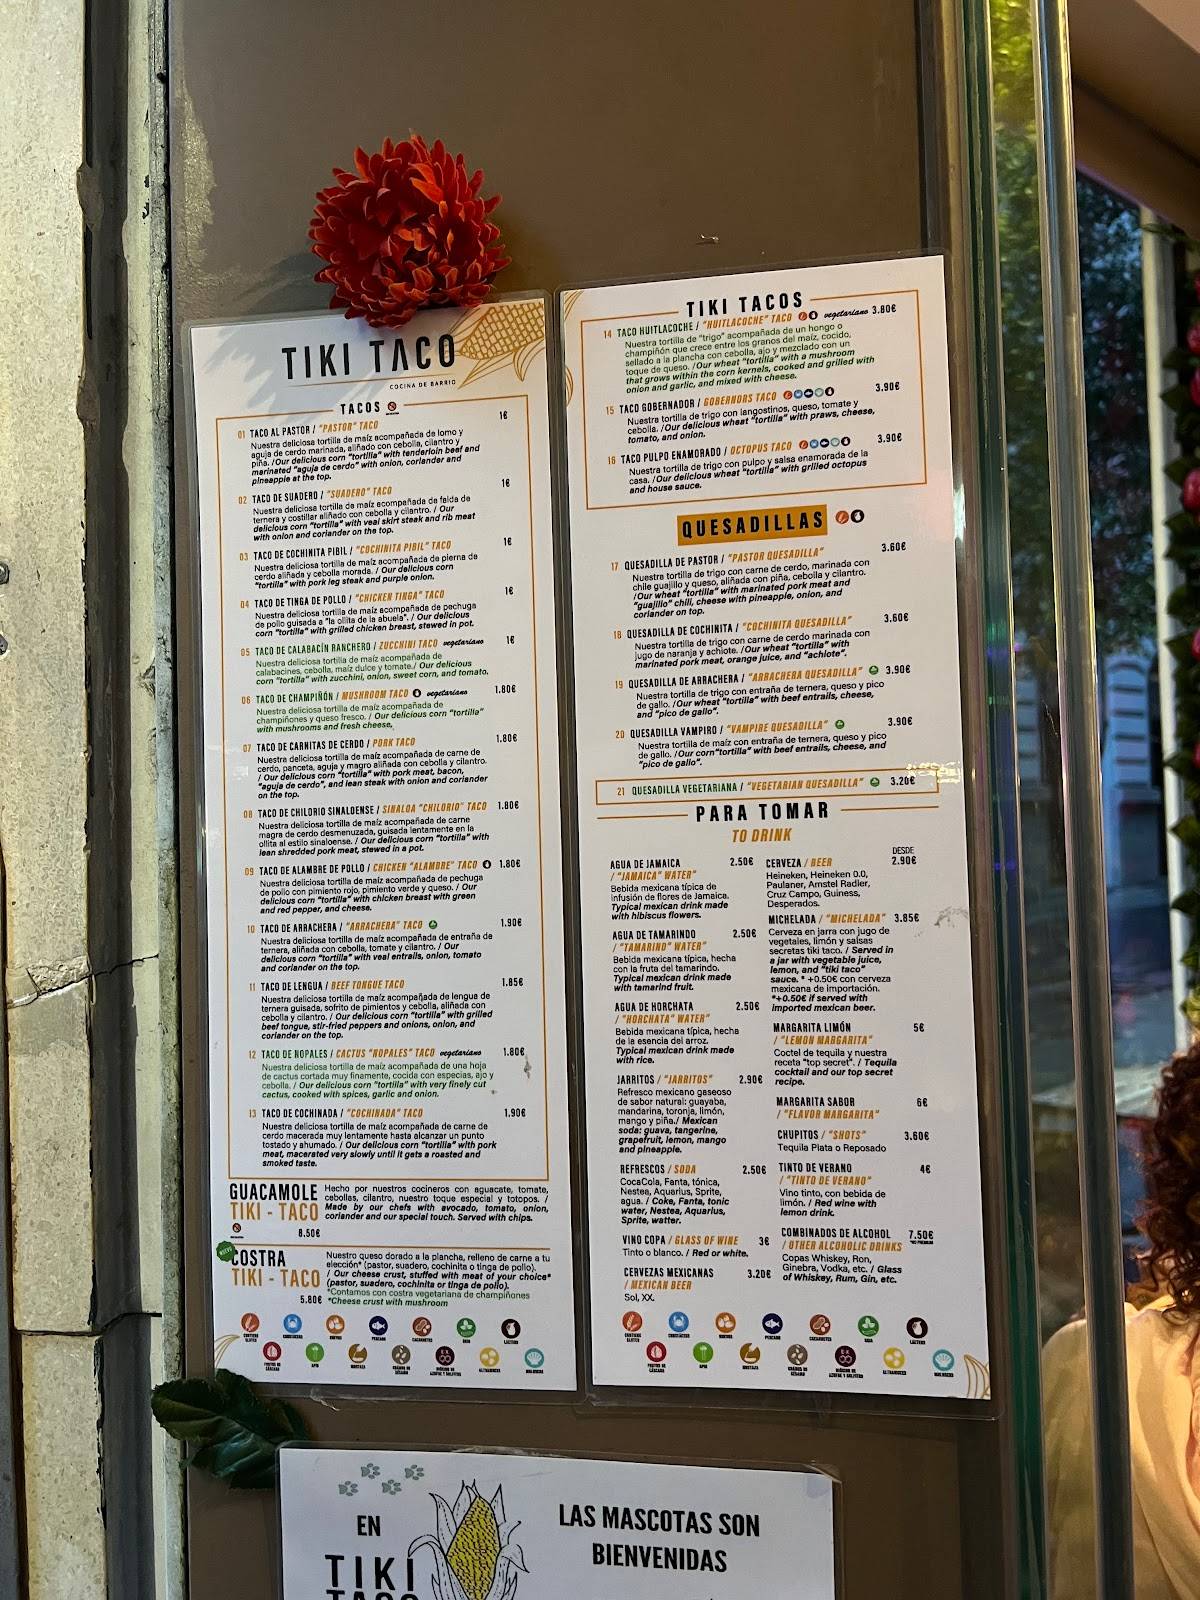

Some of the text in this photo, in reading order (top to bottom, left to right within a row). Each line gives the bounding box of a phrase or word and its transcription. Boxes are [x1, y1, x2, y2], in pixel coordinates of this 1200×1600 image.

[687, 292, 801, 317] TIKI TACOS
[872, 304, 896, 314] 3.80€
[772, 313, 792, 323] TACO
[617, 322, 693, 337] TACO HUITLACOCHE
[604, 330, 611, 339] 14
[282, 334, 456, 379] TIKI TACO
[341, 402, 380, 415] TACOS
[500, 411, 507, 420] 1€
[360, 421, 378, 430] TACO
[250, 426, 310, 438] TACO AL PASTOR
[502, 479, 510, 487] 1€
[374, 487, 392, 495] TACO
[239, 496, 247, 504] 02
[253, 491, 317, 503] TACO DE SUADERO
[682, 511, 823, 538] QUESADILLAS
[882, 542, 906, 552] 3.60€
[612, 562, 618, 571] 17
[625, 555, 718, 570] QUESADILLA DE PASTOR
[426, 590, 444, 599] TACO
[506, 587, 513, 595] 1€
[255, 595, 346, 608] TACO DE TINGA DE POLLO
[496, 685, 516, 693] 1.80€
[256, 695, 274, 703] TACO
[289, 691, 333, 702] CHAMPIÑÓN
[342, 689, 408, 700] MUSHROOM TACO
[697, 802, 827, 822] PARA TOMAR
[733, 828, 792, 842] TO DRINK
[611, 859, 680, 869] AGUA DE JAMAICA
[730, 857, 753, 866] 2.50€
[766, 859, 801, 868] CERVEZA
[811, 858, 832, 867] BEER
[892, 856, 916, 865] 2.90€
[767, 870, 868, 882] Heineken, Heineken 0.0,
[789, 891, 821, 899] Campo,
[404, 921, 422, 929] TACO
[501, 918, 521, 927] 1.90€
[248, 925, 255, 933] 10
[261, 923, 336, 933] TACO DE ARRACHERA
[261, 964, 276, 972] and
[774, 1021, 850, 1032] MARGARITA LIMÓN
[914, 1023, 924, 1032] 5€
[617, 1075, 654, 1084] JARRITOS
[740, 1075, 762, 1084] 2.90€
[262, 1109, 337, 1118] TACO DE COCHINADA
[404, 1109, 423, 1117] TACO
[505, 1108, 525, 1117] 1.90€
[326, 1134, 342, 1143] muy
[414, 1132, 446, 1140] alcanzar
[462, 1132, 484, 1141] punto
[778, 1130, 818, 1139] CHUPITOS
[905, 1132, 929, 1140] 3.60€
[778, 1144, 808, 1152] Tequila
[844, 1144, 886, 1153] Reposado
[230, 1183, 317, 1201] GUACAMOLE
[231, 1202, 260, 1220] TIKI
[279, 1203, 318, 1221] TACO
[299, 1229, 320, 1237] 8.50€
[782, 1228, 891, 1238] COMBINADOS DE ALCOHOL
[909, 1230, 933, 1239] 7.50€
[623, 1235, 665, 1244] VINO COPA
[675, 1236, 738, 1245] GLASS OF WINE
[759, 1237, 769, 1246] 3€
[623, 1248, 643, 1256] Tinto
[654, 1248, 683, 1256] blanco.
[231, 1249, 285, 1266] COSTRA
[232, 1268, 262, 1286] TIKI
[280, 1269, 320, 1288] TACO
[301, 1295, 322, 1304] 5.80€
[386, 1298, 402, 1306] with
[560, 1504, 759, 1537] LAS MASCOTAS SON
[358, 1516, 380, 1536] EN
[593, 1543, 726, 1572] BIENVENIDAS
[325, 1554, 413, 1591] TIKI
